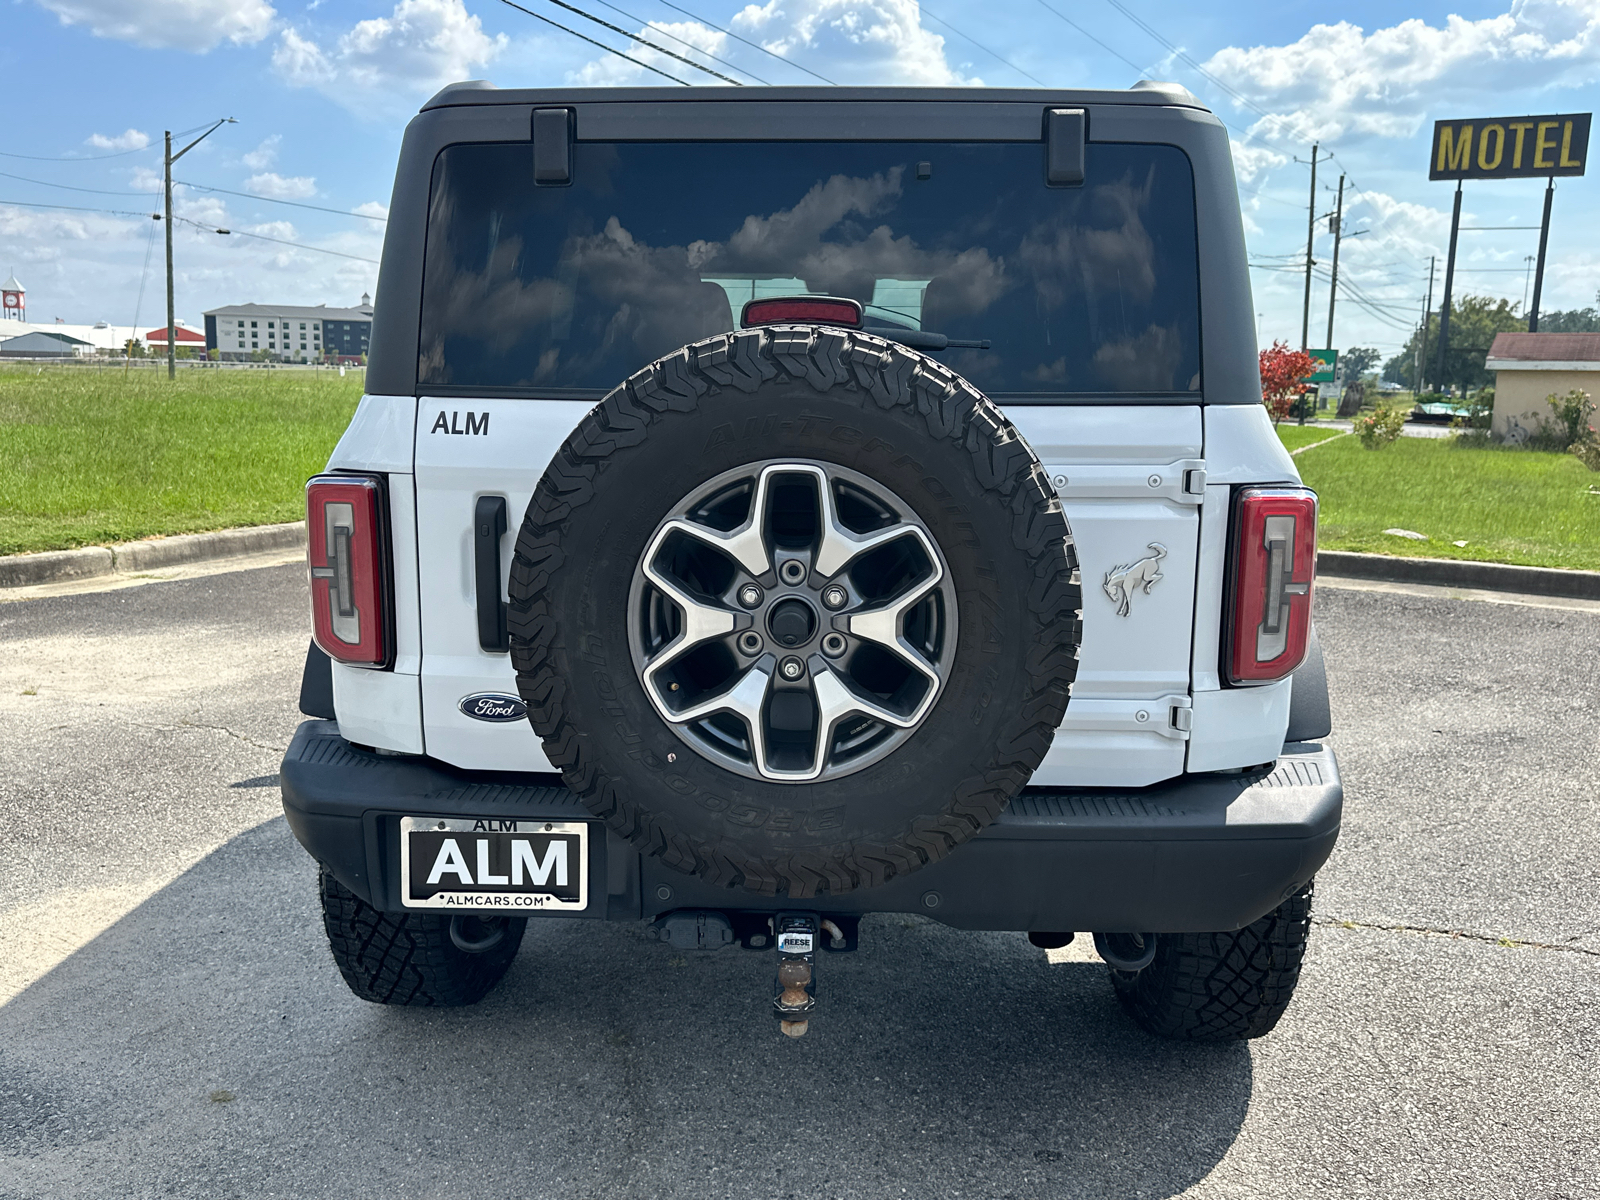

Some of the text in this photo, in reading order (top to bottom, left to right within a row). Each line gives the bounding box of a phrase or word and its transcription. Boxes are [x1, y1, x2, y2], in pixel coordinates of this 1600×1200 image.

[1436, 120, 1581, 172] MOTEL
[430, 410, 490, 436] ALM
[701, 413, 983, 550] All-Terrain
[474, 698, 515, 716] Ford
[582, 633, 847, 833] BFGoodrich
[472, 819, 518, 832] ALM
[425, 838, 568, 886] ALM
[446, 895, 544, 907] ALMCARS.COM
[784, 938, 811, 946] REESE
